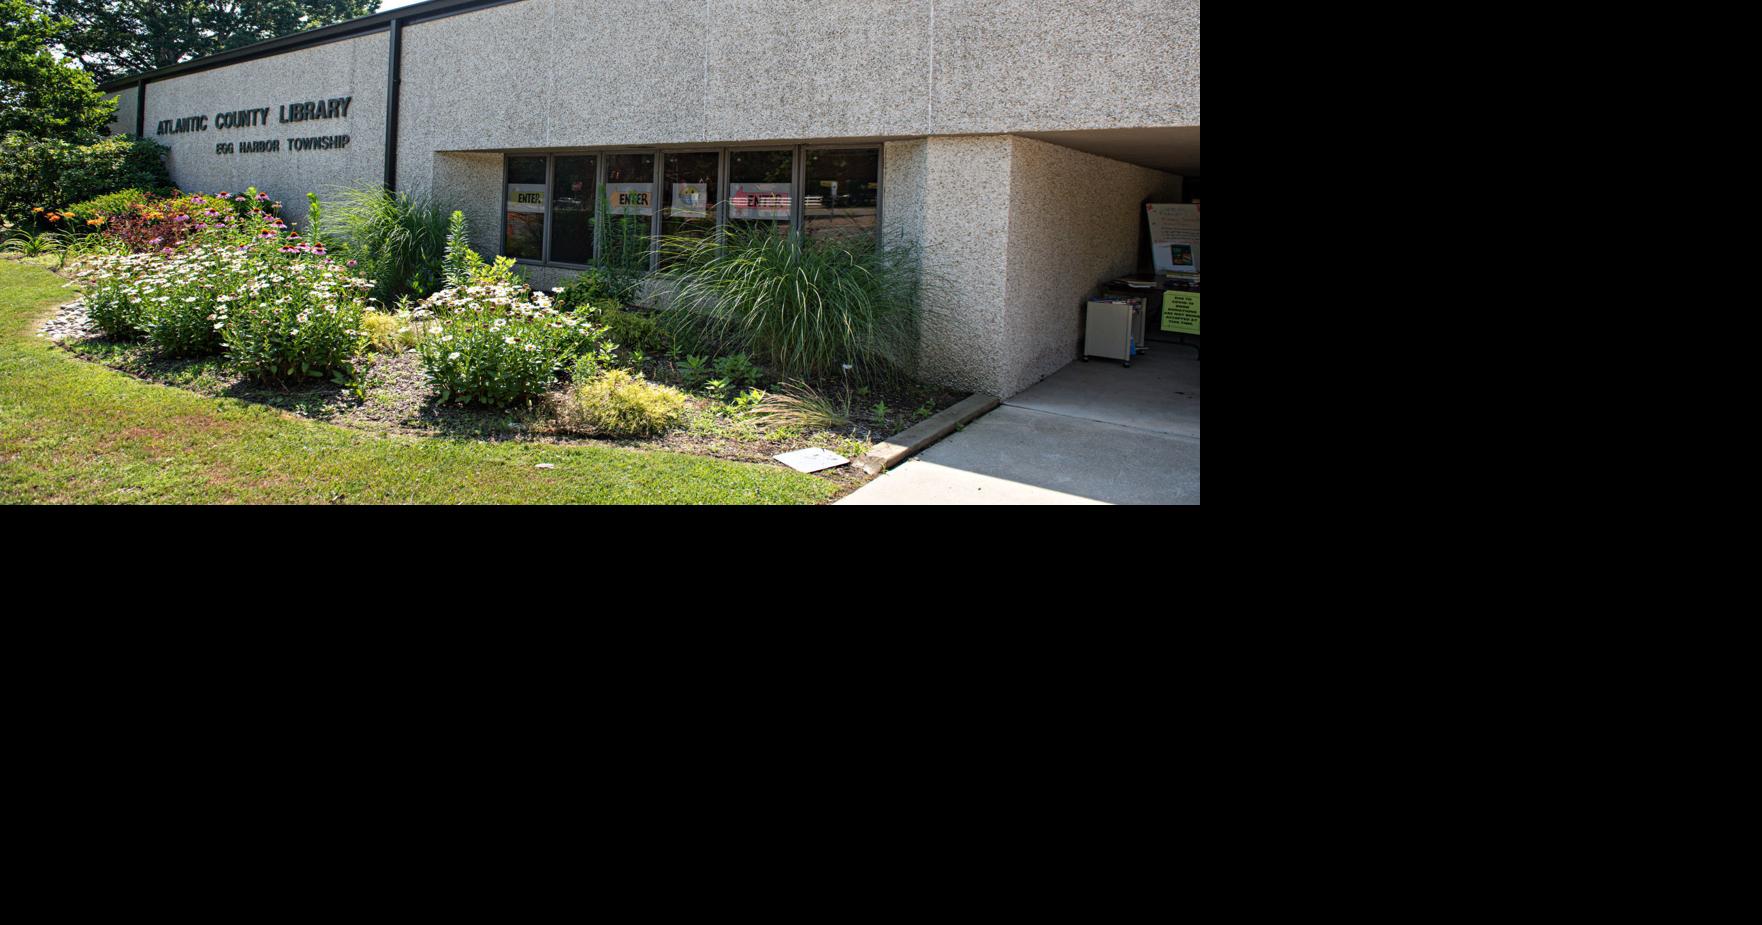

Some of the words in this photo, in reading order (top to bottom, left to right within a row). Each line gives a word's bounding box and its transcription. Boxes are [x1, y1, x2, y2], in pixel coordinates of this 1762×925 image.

[157, 115, 208, 135] ATLANTIC
[215, 107, 270, 130] COUNTY
[279, 96, 352, 124] LIBRARY
[216, 143, 234, 155] EGG
[239, 139, 280, 154] HARBOR
[287, 134, 350, 151] TOWNSHIP
[518, 193, 541, 204] ENTER
